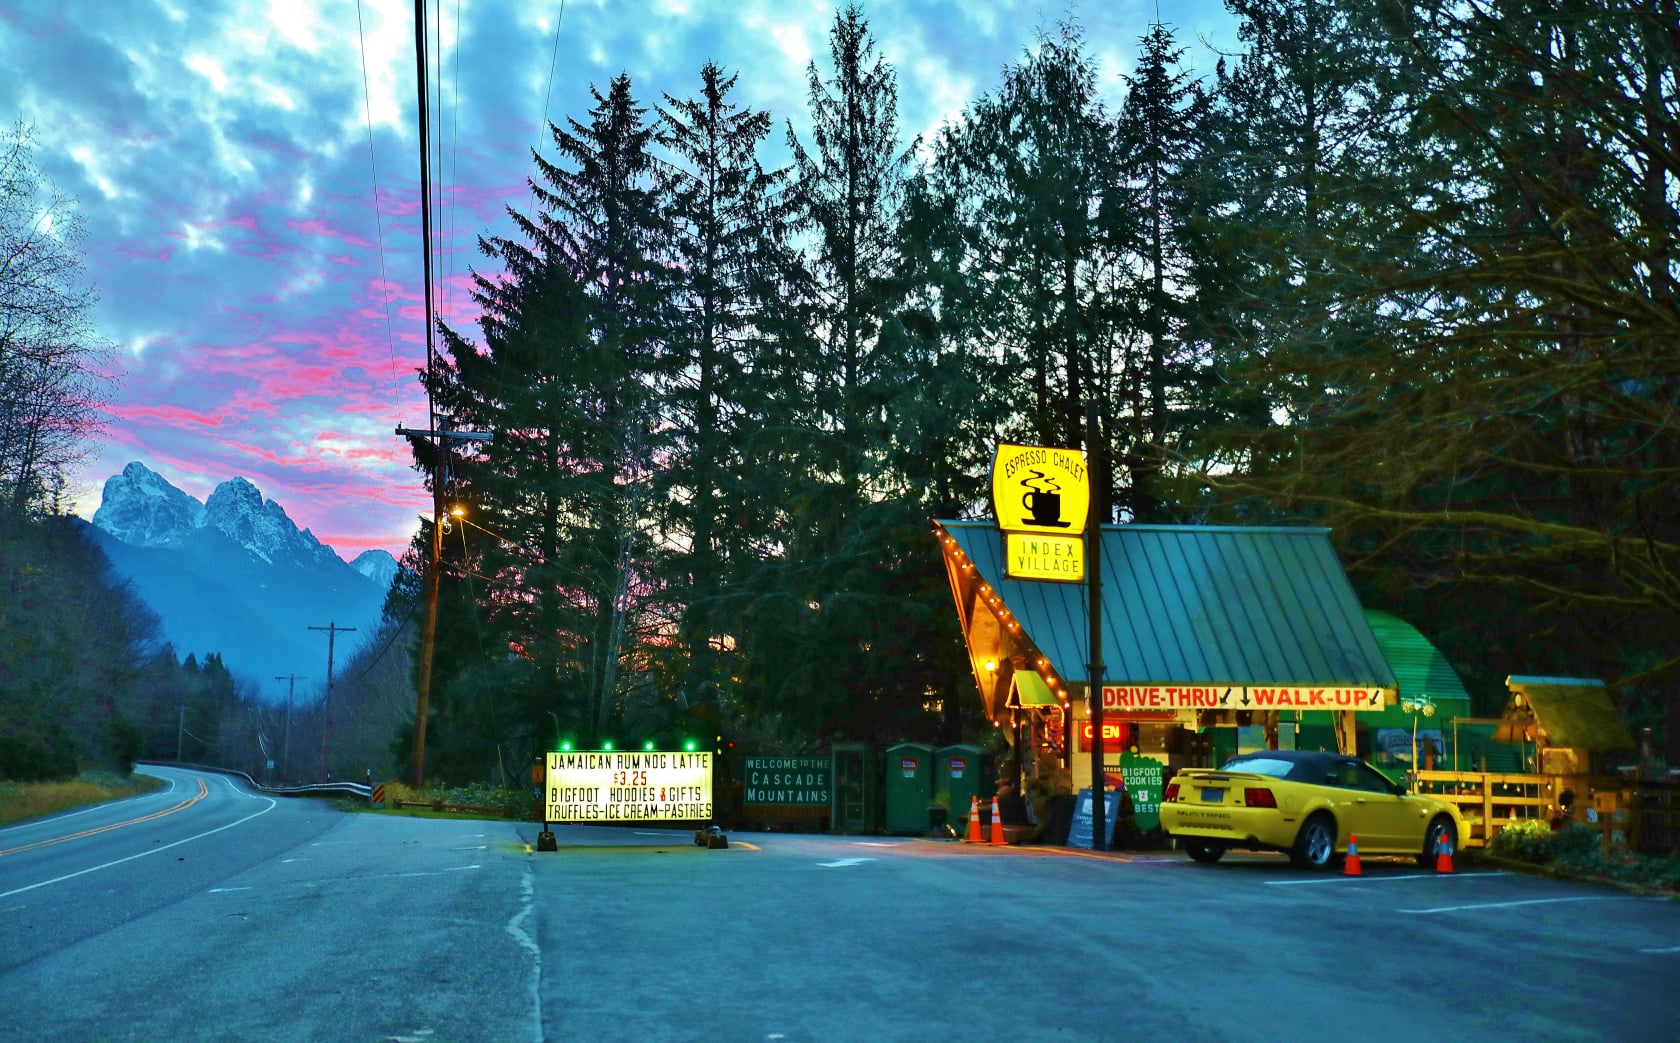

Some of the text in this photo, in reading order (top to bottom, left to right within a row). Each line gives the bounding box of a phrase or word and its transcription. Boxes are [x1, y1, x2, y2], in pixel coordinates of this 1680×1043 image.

[1005, 450, 1084, 483] ESPRESSO CHALET
[1022, 541, 1074, 557] INDEX
[1018, 556, 1079, 573] VILLAGE
[1103, 687, 1368, 707] DRIVE-THRU WALK-UP
[1084, 725, 1119, 738] OEN
[551, 753, 708, 770] JAMAICAN RUM NOG LATTE
[747, 759, 830, 769] WELCOME TO THE
[613, 770, 647, 786] $3.25
[752, 771, 825, 786] CASCADE
[1122, 767, 1161, 777] BIGFOOT
[1124, 776, 1163, 786] COOKIES
[551, 787, 600, 803] BIGFOOT
[609, 787, 655, 802] HOODIES
[669, 786, 701, 802] GIFTS
[747, 787, 828, 803] MOUNTAINS
[1134, 803, 1160, 813] BEST
[1177, 810, 1231, 819] MUSTANG
